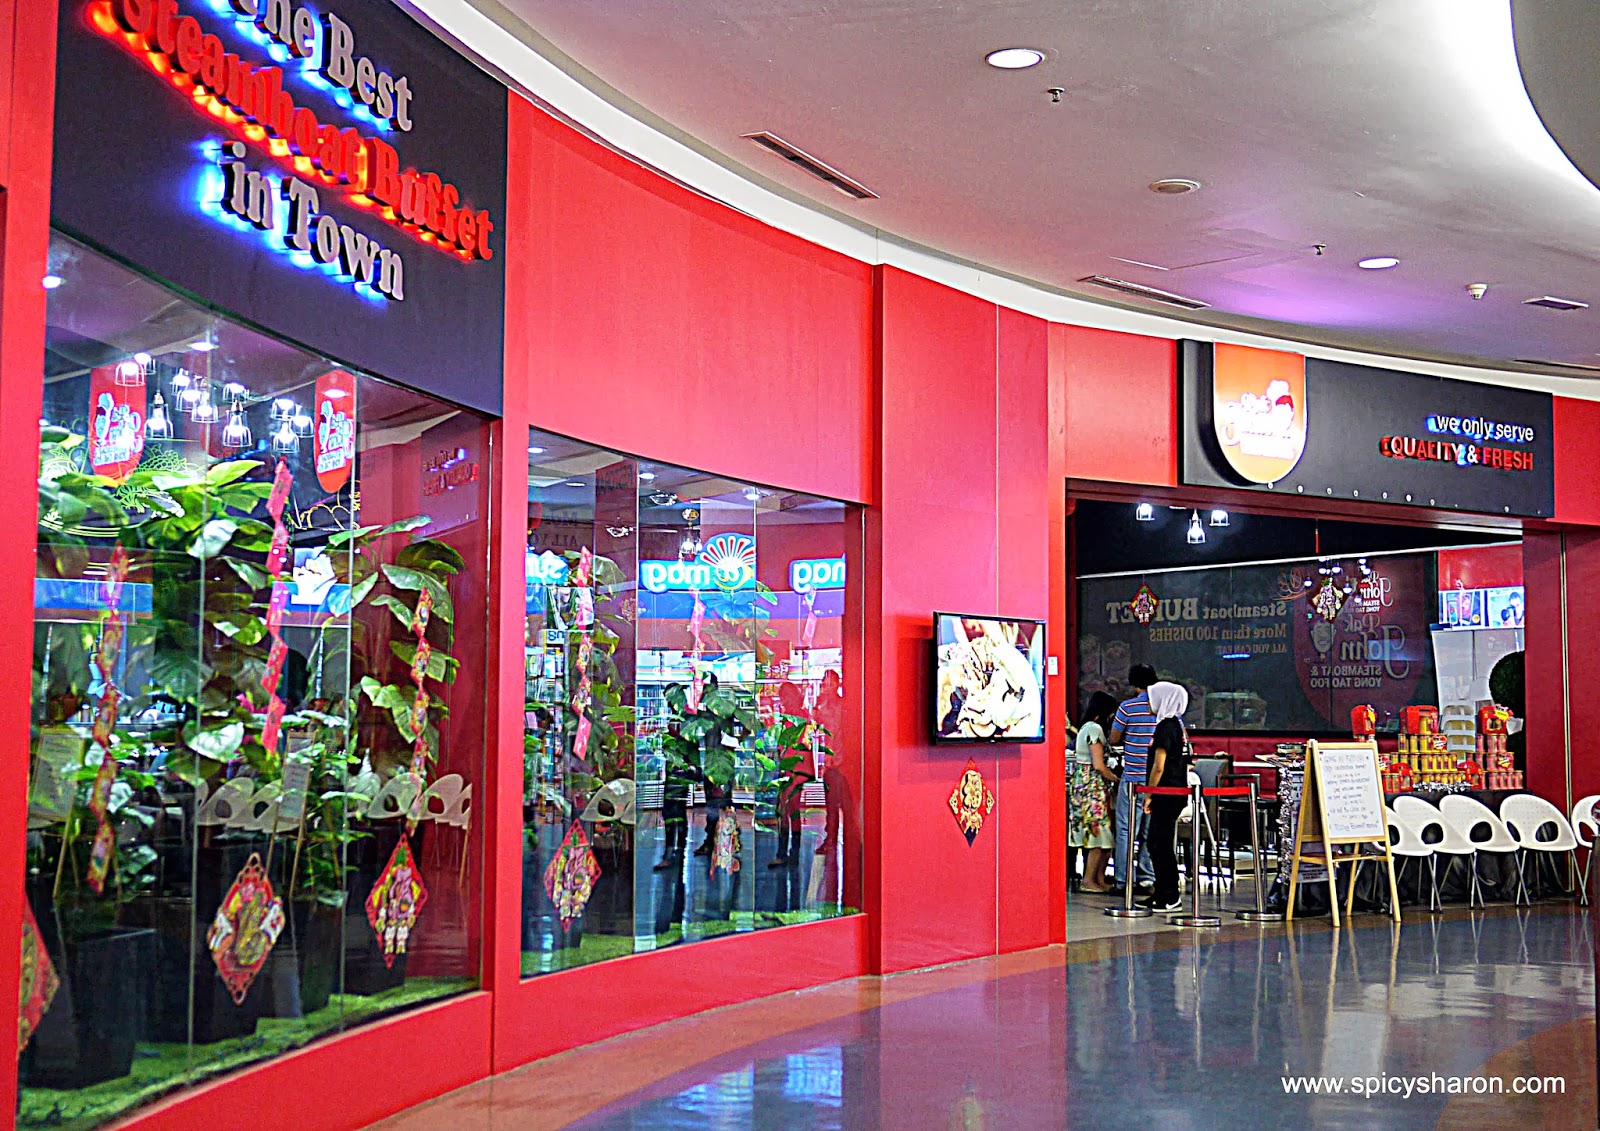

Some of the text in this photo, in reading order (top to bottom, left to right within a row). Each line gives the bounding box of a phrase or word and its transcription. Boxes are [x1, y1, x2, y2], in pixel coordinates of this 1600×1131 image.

[232, 0, 413, 132] he Best
[224, 141, 404, 301] in Town
[365, 136, 494, 261] Buffet
[1390, 435, 1534, 471] QUALITY & FRESH
[1437, 414, 1534, 443] we only serve
